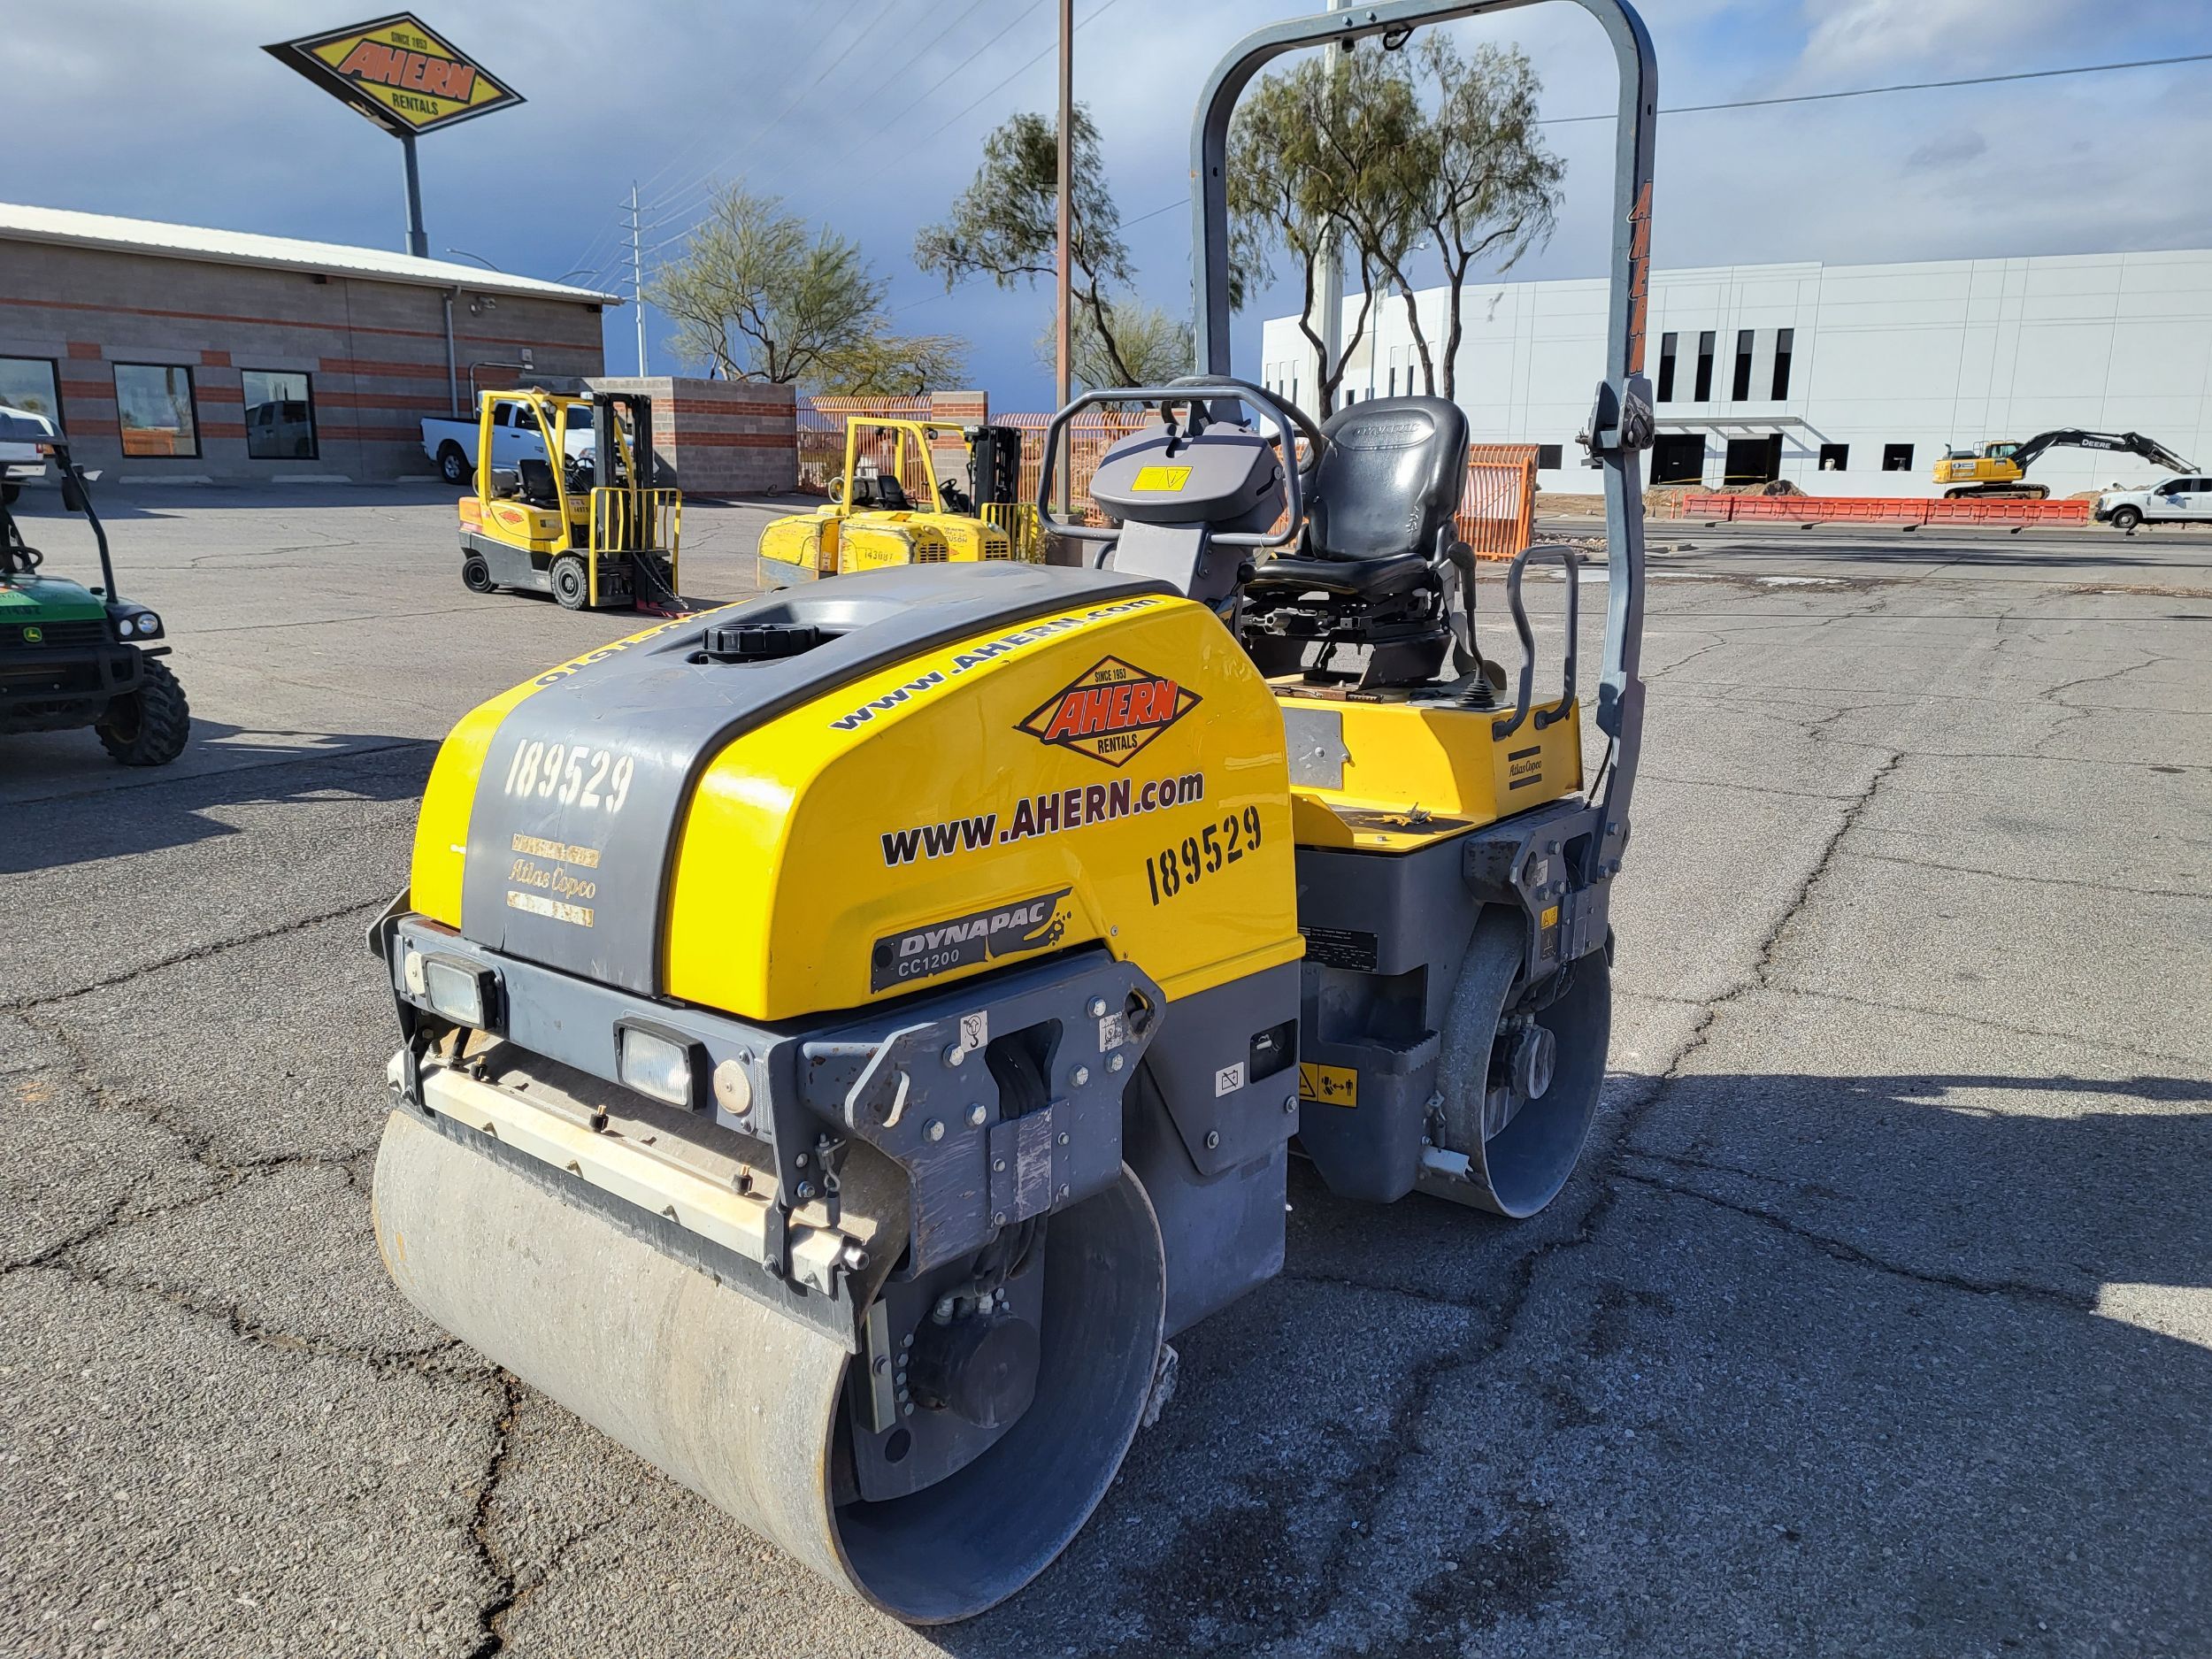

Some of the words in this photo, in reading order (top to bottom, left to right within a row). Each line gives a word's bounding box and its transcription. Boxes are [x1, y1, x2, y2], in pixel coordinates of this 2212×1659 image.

[391, 31, 410, 45] SINCE
[338, 42, 475, 101] AHERN
[392, 92, 439, 116] RENTALS
[2082, 439, 2111, 449] DEERE
[1094, 671, 1111, 682] SINCE
[1113, 668, 1126, 680] 1953
[1045, 680, 1179, 740] AHERN
[1097, 733, 1138, 754] RENTALS
[505, 739, 634, 814] 189529
[1509, 764, 1526, 777] Atlas
[1526, 760, 1541, 772] Copco
[1146, 805, 1263, 906] 189529
[508, 858, 550, 888] Atlas
[551, 867, 596, 900] Copco
[899, 902, 1046, 957] DYNAPAC
[898, 949, 960, 977] CC1200
